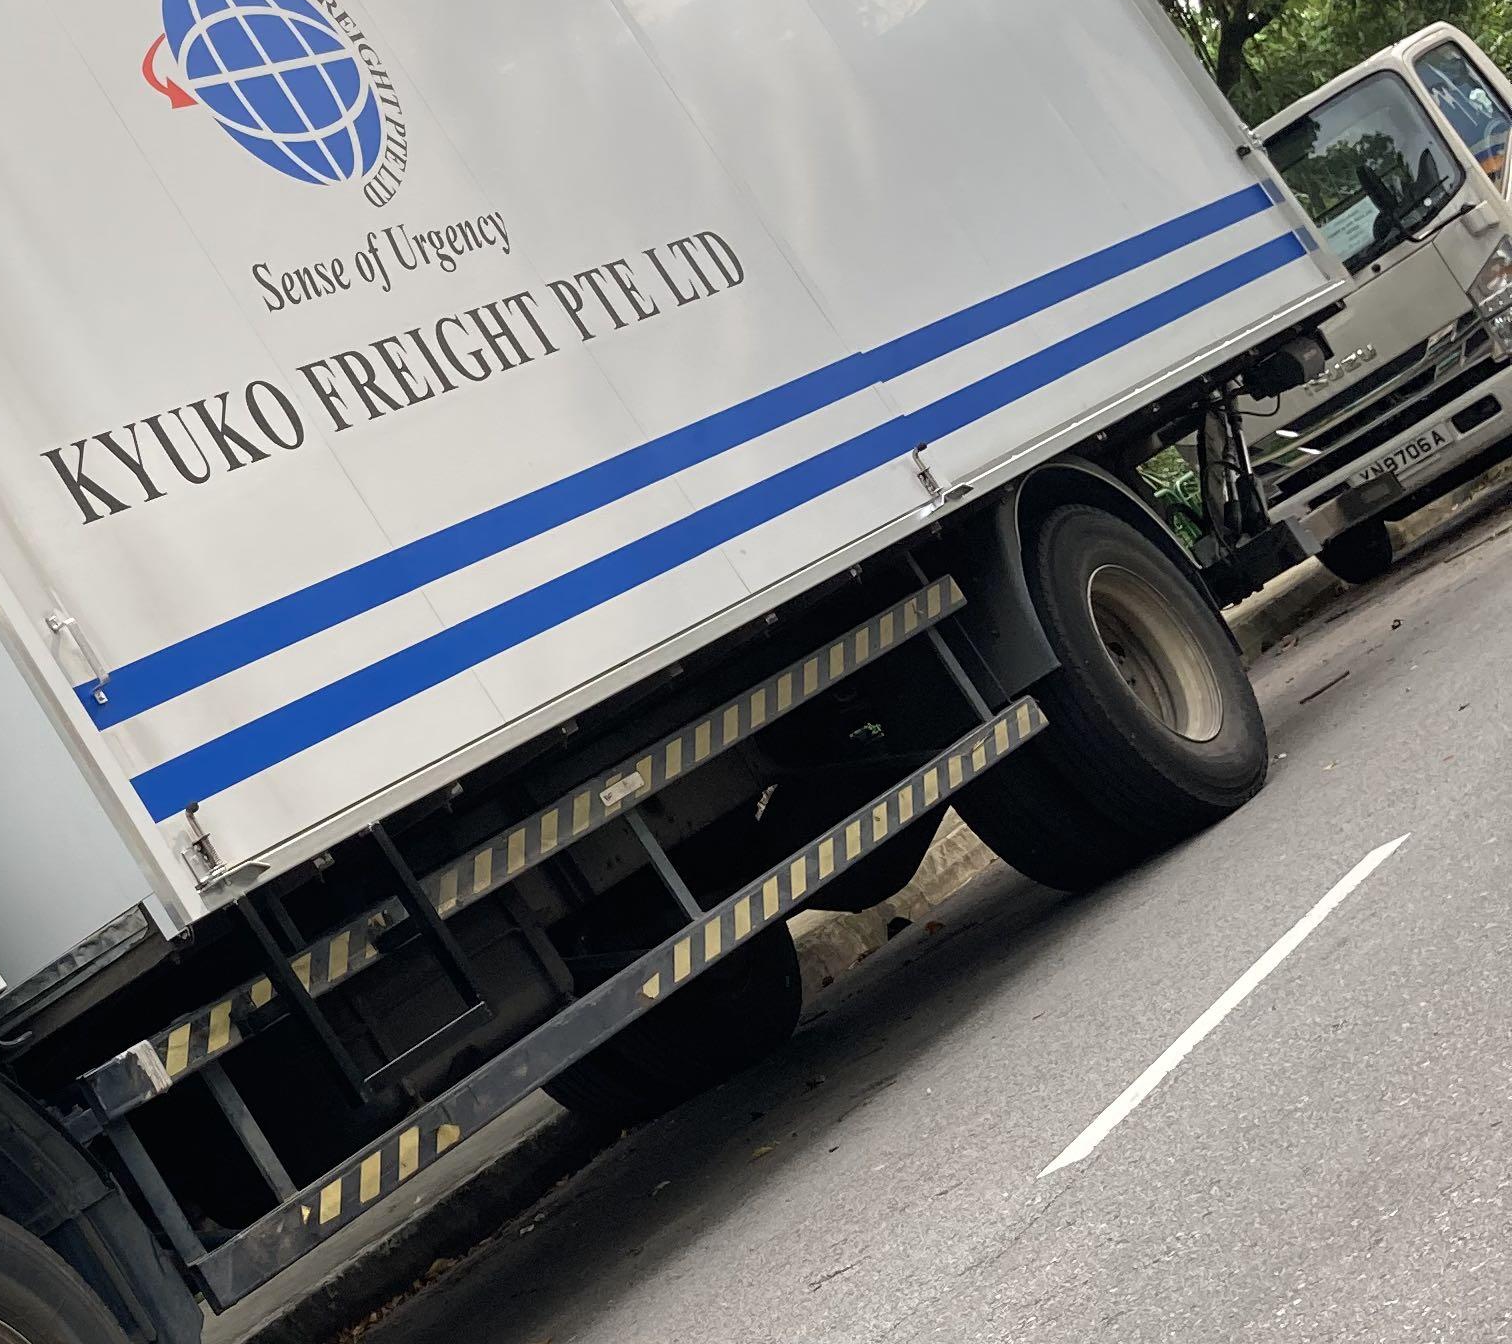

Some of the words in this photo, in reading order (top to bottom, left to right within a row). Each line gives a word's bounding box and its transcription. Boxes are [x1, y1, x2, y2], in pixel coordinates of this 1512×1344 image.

[384, 114, 408, 173] PTE
[362, 162, 403, 208] LTD
[251, 250, 352, 314] Sense
[356, 232, 391, 295] of
[387, 209, 513, 278] Urgency
[40, 377, 304, 525] KYUKO
[296, 291, 560, 432] FREIGHT
[547, 247, 662, 343] PTE
[660, 228, 746, 308] LTD
[1304, 344, 1378, 396] ISUZU
